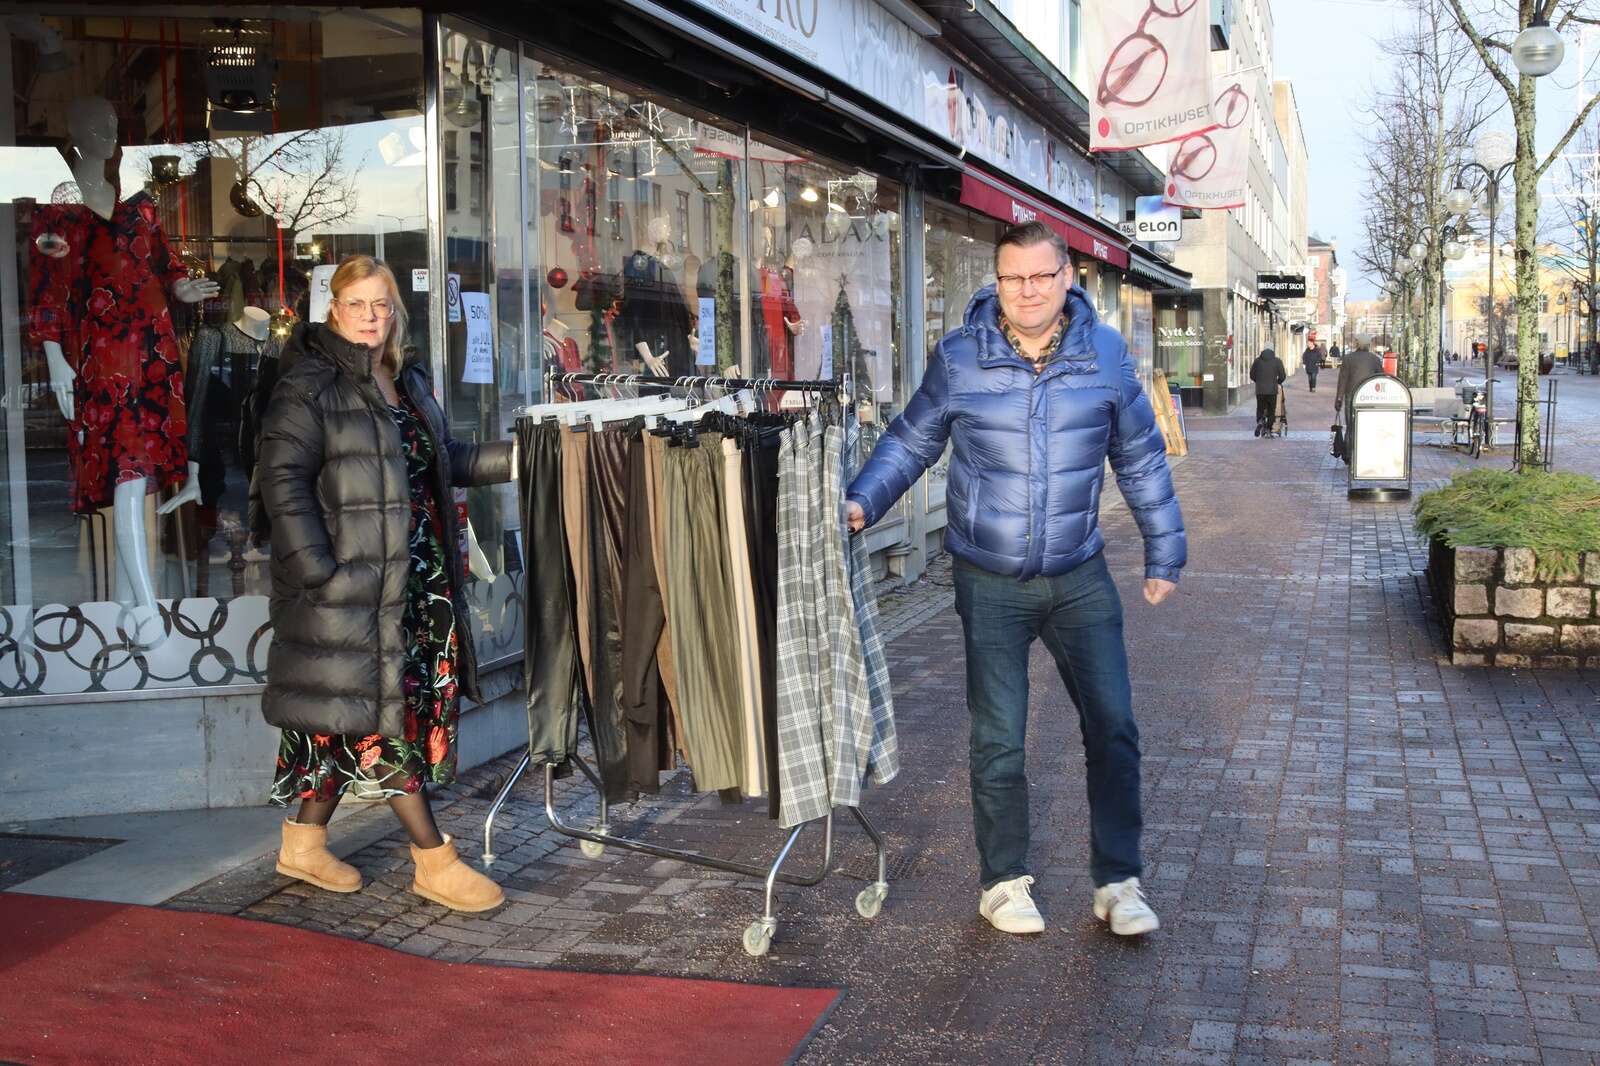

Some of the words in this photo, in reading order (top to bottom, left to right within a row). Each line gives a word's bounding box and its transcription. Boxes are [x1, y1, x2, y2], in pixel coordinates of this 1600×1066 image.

[1124, 103, 1211, 135] OPTIKHUSET
[1184, 188, 1244, 201] OPTIKHUSET
[1158, 326, 1183, 339] Nytt
[1185, 326, 1197, 337] &
